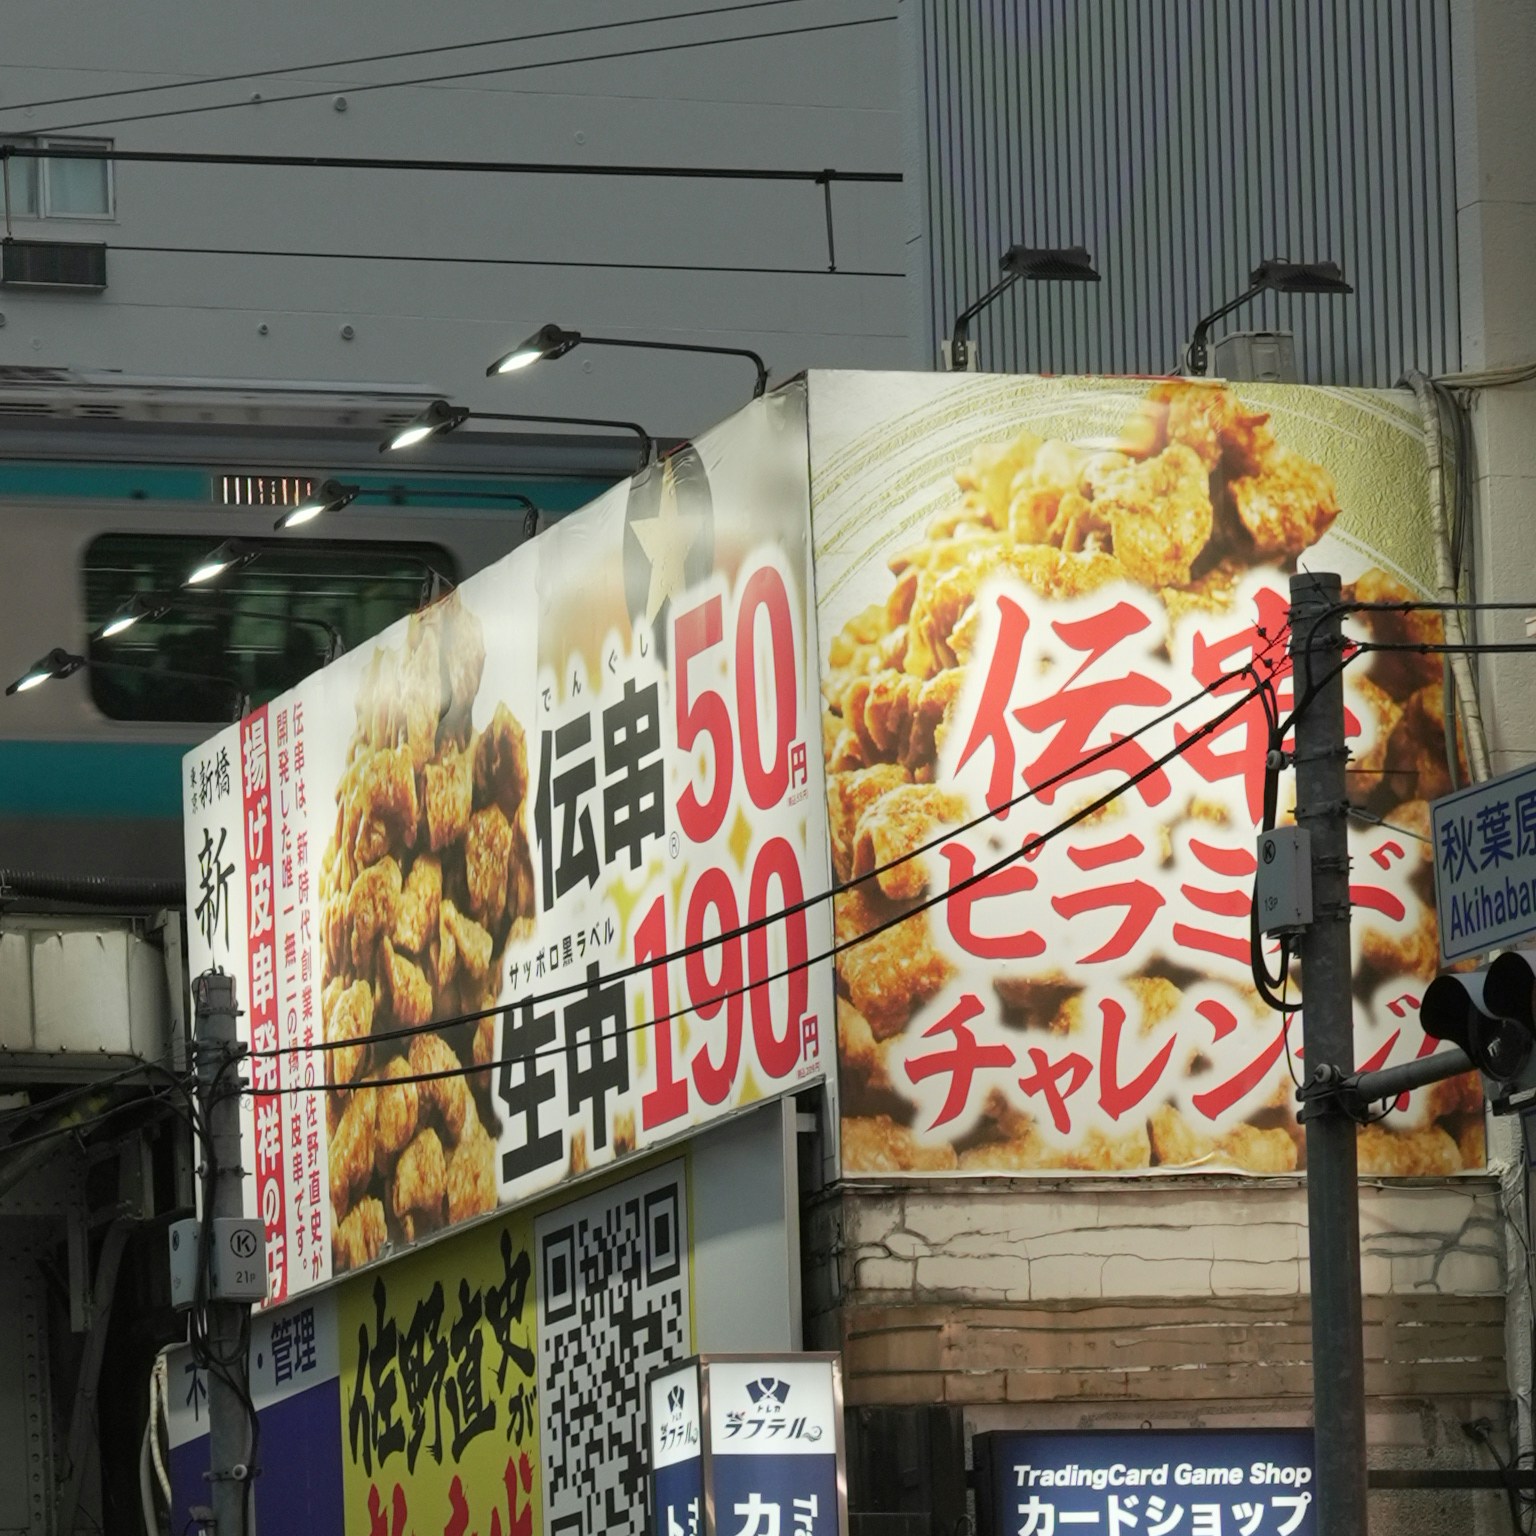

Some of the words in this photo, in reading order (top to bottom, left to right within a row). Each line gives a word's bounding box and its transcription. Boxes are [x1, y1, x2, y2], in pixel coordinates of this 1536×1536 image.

[534, 677, 666, 912] 伝串
[675, 565, 798, 843] 50
[791, 741, 808, 789] 円
[954, 585, 1362, 828] 伝串
[509, 917, 615, 991] サッポロ黒ラベル
[634, 837, 810, 1132] 190
[803, 1015, 819, 1061] 円
[499, 960, 630, 1185] 生中
[1014, 1465, 1170, 1490] TradingCard
[1174, 1463, 1245, 1487] Game
[1250, 1462, 1312, 1489] Shop
